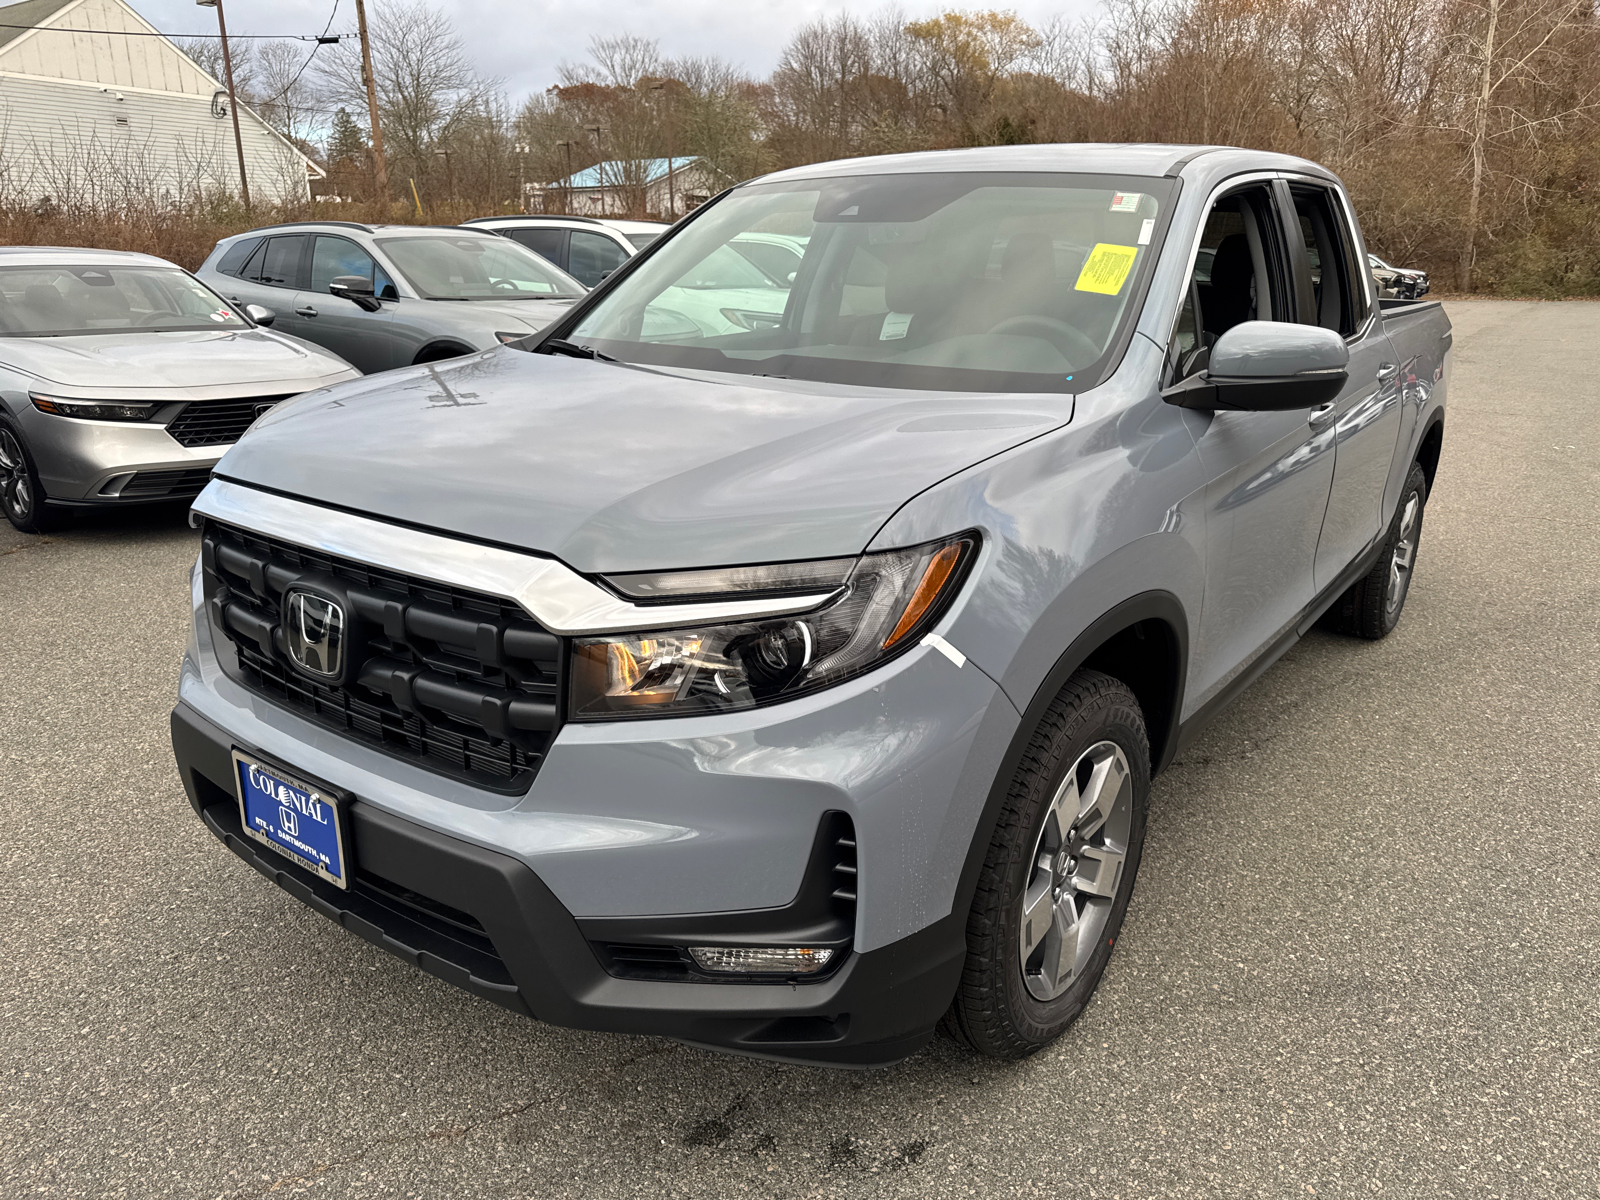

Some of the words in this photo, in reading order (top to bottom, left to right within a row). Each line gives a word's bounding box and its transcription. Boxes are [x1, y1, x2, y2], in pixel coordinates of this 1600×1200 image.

[250, 769, 327, 825] COLONIAL
[267, 840, 296, 860] COLONIAL
[297, 857, 319, 874] HONDA
[278, 829, 319, 859] DARTMOUTH,
[319, 852, 331, 864] MA
